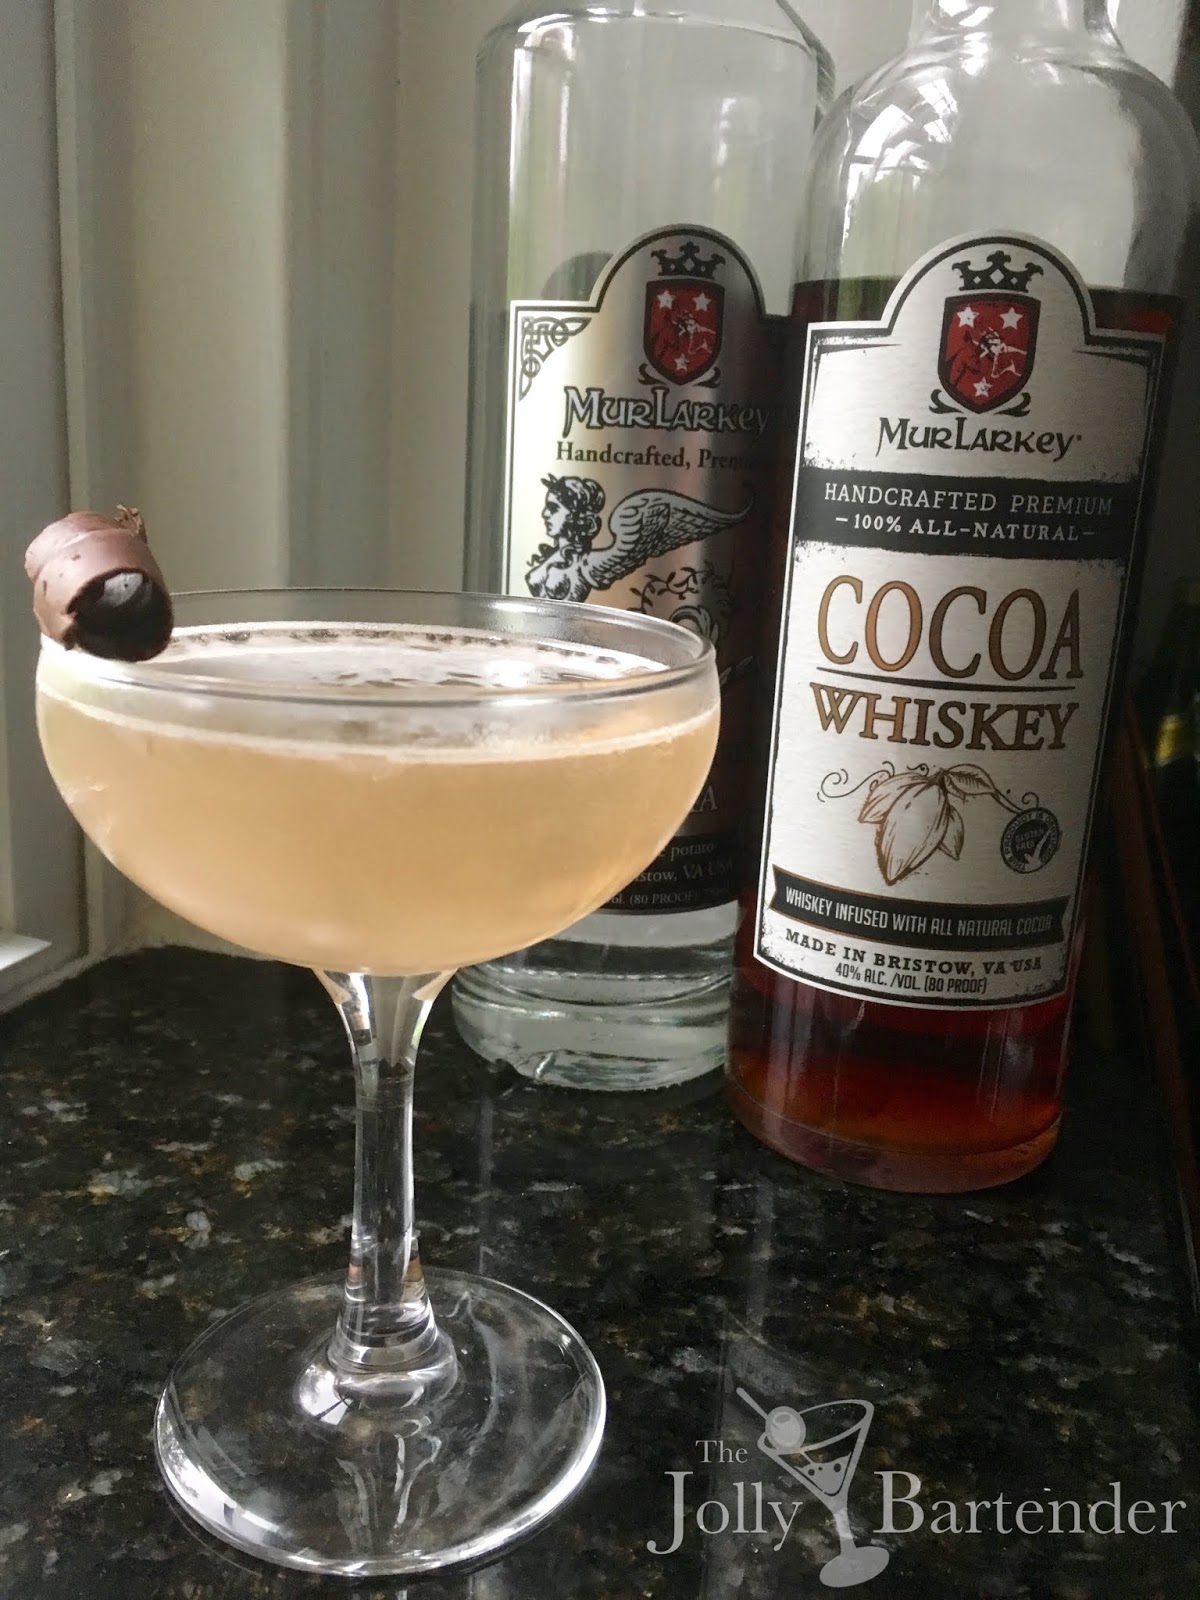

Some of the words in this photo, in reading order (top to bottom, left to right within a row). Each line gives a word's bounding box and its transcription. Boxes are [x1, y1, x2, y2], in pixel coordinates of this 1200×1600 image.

[555, 441, 691, 470] Handcrafted,
[824, 482, 997, 512] HANDCRAFTED
[1009, 494, 1112, 516] PREMIUM
[817, 575, 1084, 681] COCOA
[809, 682, 1080, 751] WHISKEY
[670, 841, 715, 861] potato
[785, 886, 832, 917] WHISKEY
[835, 902, 888, 929] INFUSED
[892, 913, 927, 934] WITH
[931, 917, 953, 936] ALL
[957, 917, 1013, 937] NATURAL
[1016, 913, 1052, 935] COCOA
[785, 927, 837, 957] MADE
[843, 946, 867, 963] IN
[874, 952, 975, 977] BRISTOW,
[982, 961, 1006, 974] VA
[835, 962, 861, 981] 40%
[946, 976, 987, 994] PROOF)
